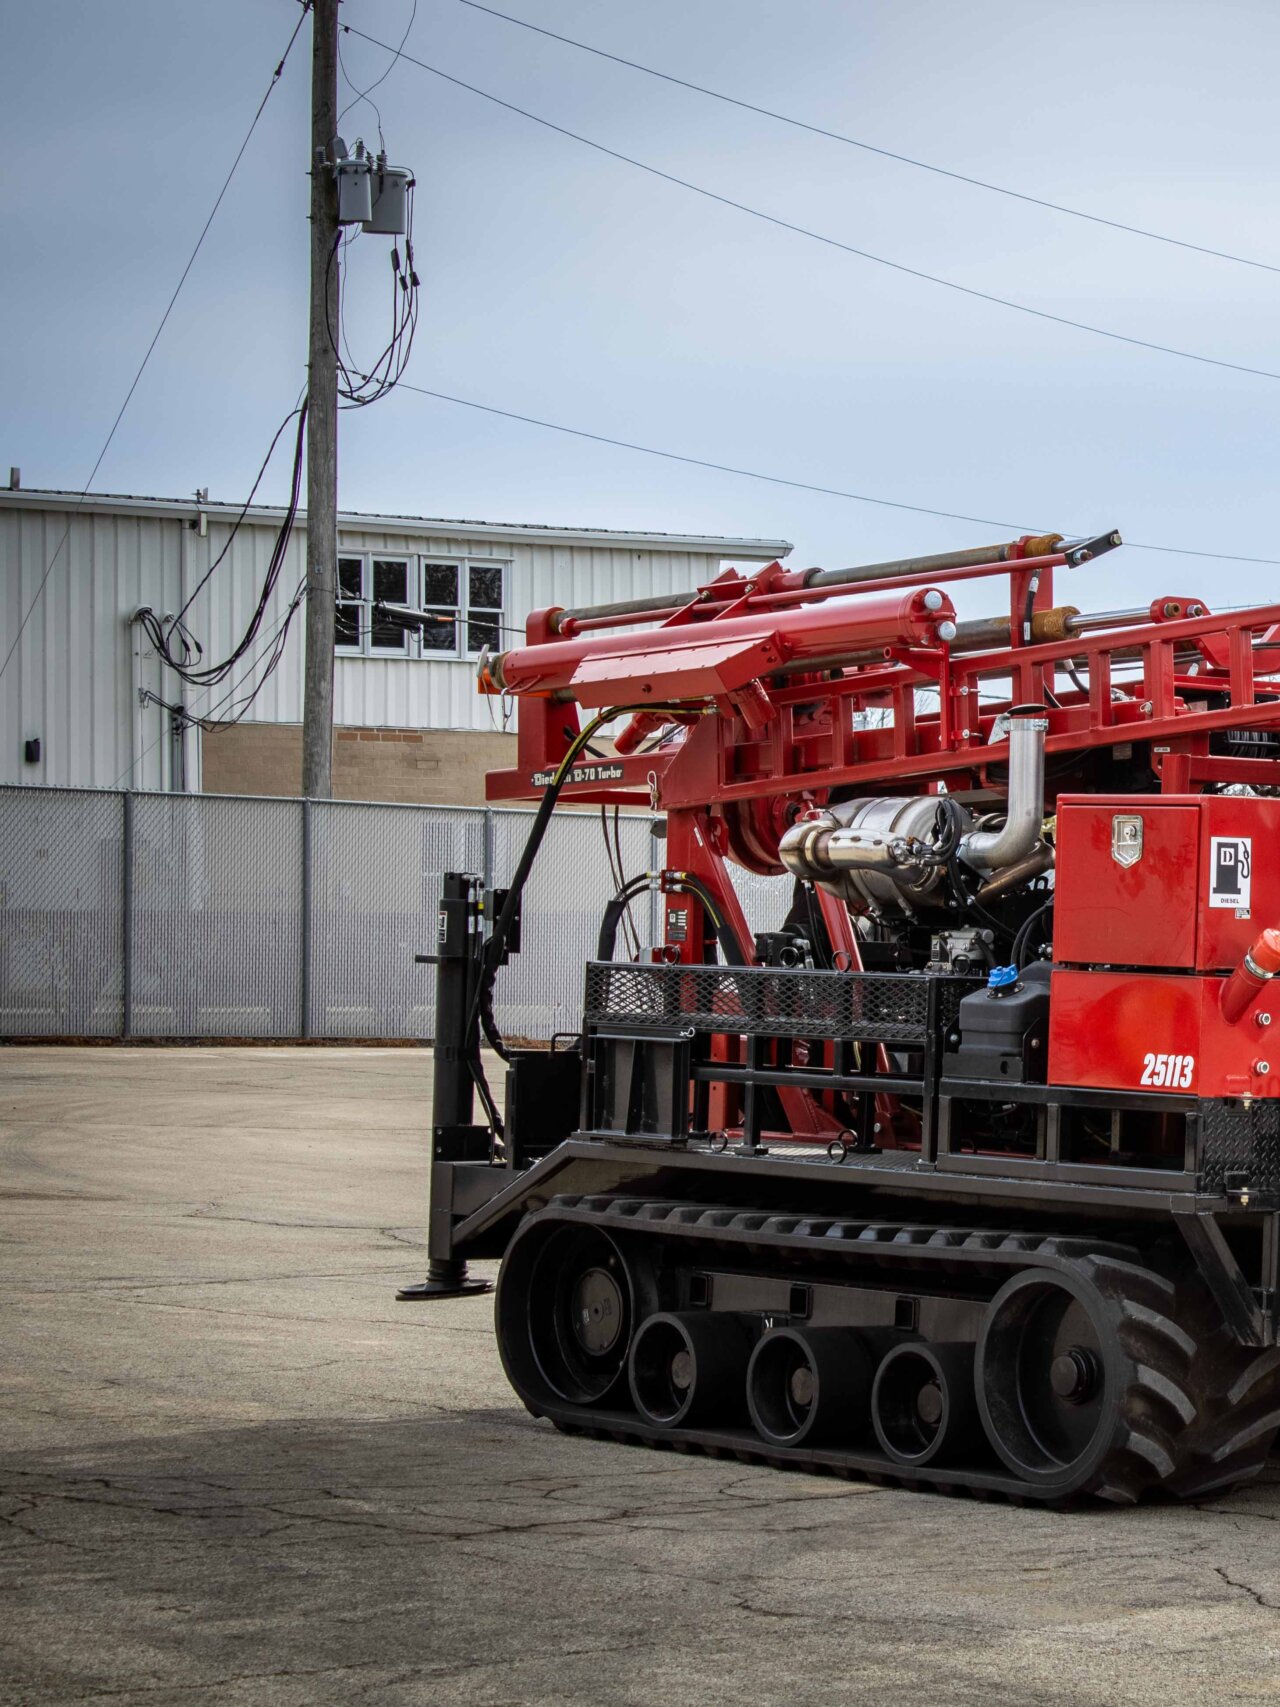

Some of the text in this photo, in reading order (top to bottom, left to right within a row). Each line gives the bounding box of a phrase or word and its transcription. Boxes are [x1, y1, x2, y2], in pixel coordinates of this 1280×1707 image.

[574, 768, 595, 781] D-70
[598, 766, 622, 779] Turbo
[1223, 850, 1232, 862] D
[1140, 1053, 1195, 1088] 25113
